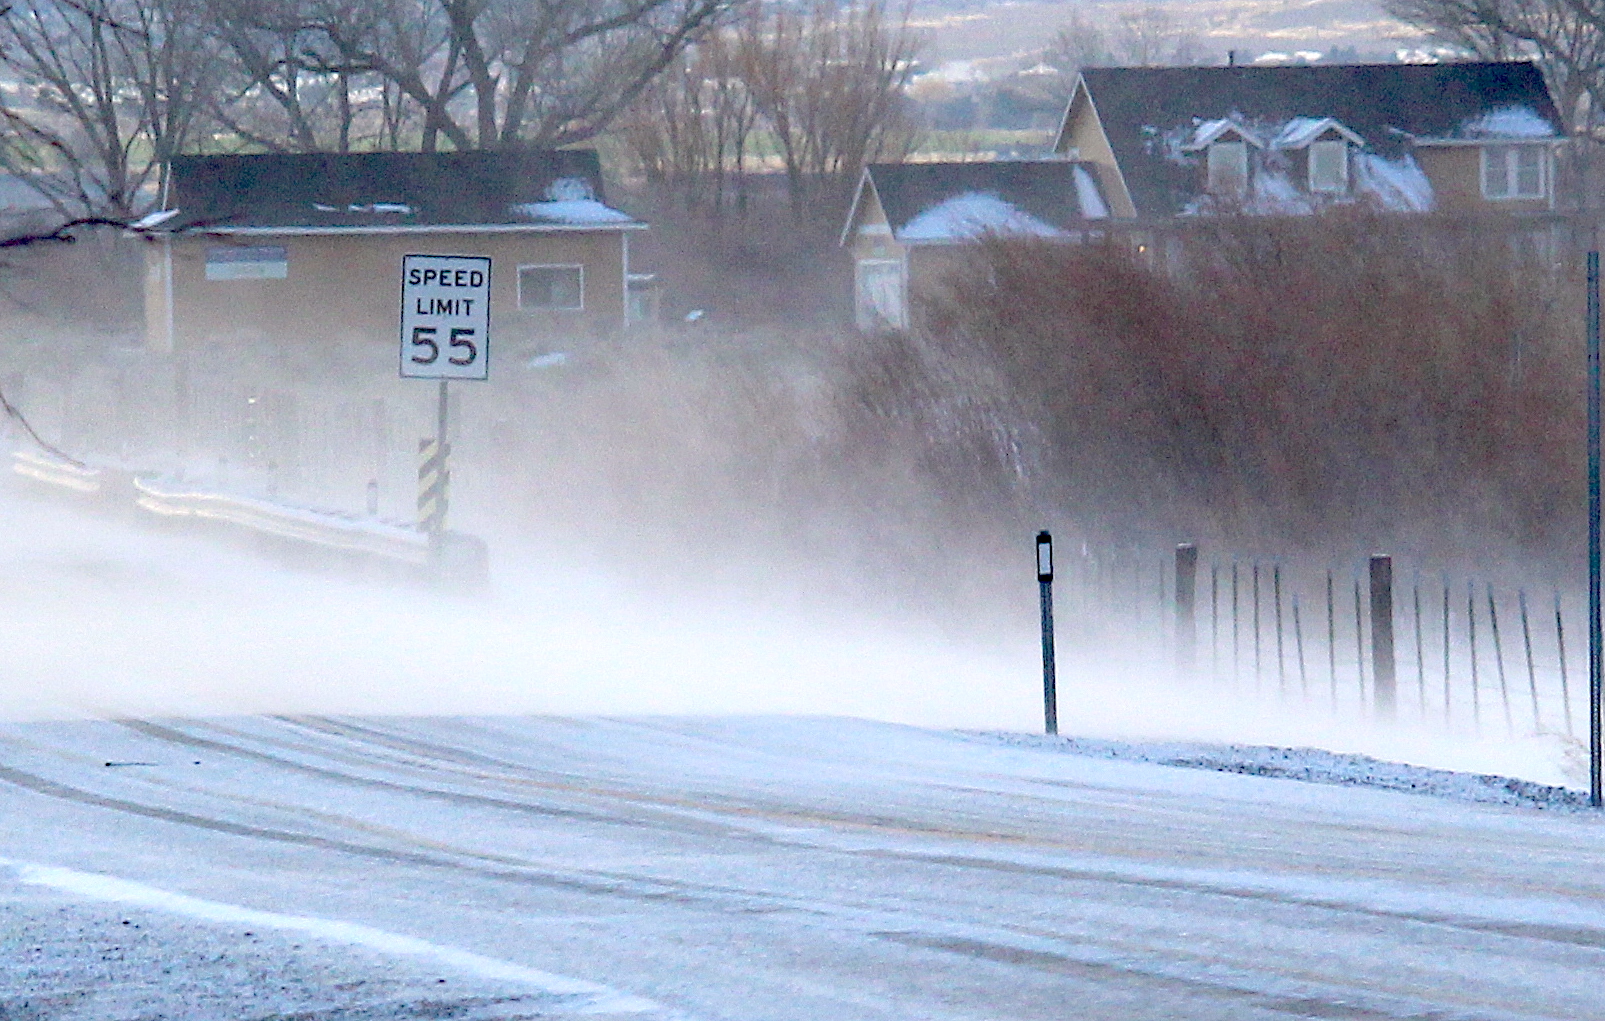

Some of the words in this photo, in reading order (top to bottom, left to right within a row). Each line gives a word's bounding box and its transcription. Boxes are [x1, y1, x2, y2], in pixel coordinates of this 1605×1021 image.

[409, 269, 484, 287] SPEED
[416, 297, 475, 316] LIMIT
[411, 326, 477, 366] 55
